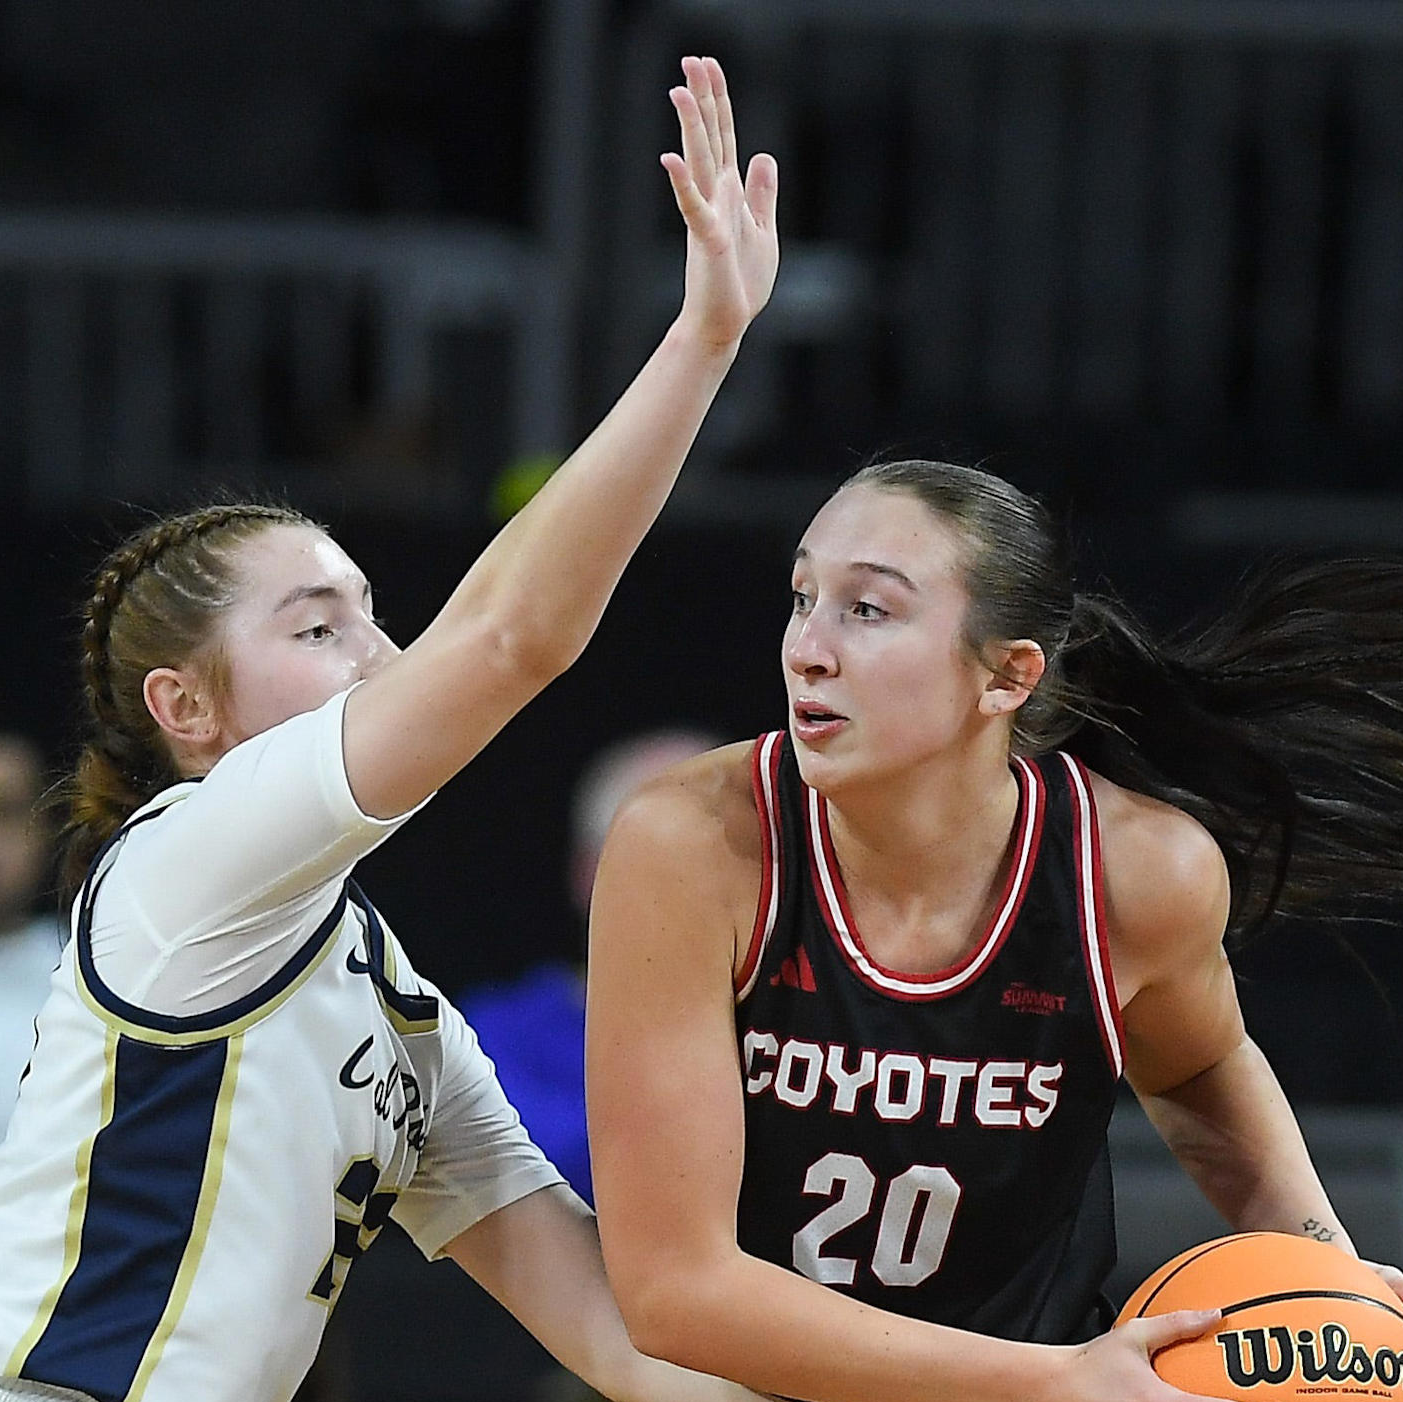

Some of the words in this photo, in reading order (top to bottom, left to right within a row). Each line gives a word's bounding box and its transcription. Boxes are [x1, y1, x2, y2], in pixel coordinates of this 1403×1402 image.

[743, 1028, 1065, 1129] COYOTES
[791, 1151, 962, 1288] 20
[1341, 1387, 1369, 1395] GAME
[1372, 1389, 1393, 1398] BALL
